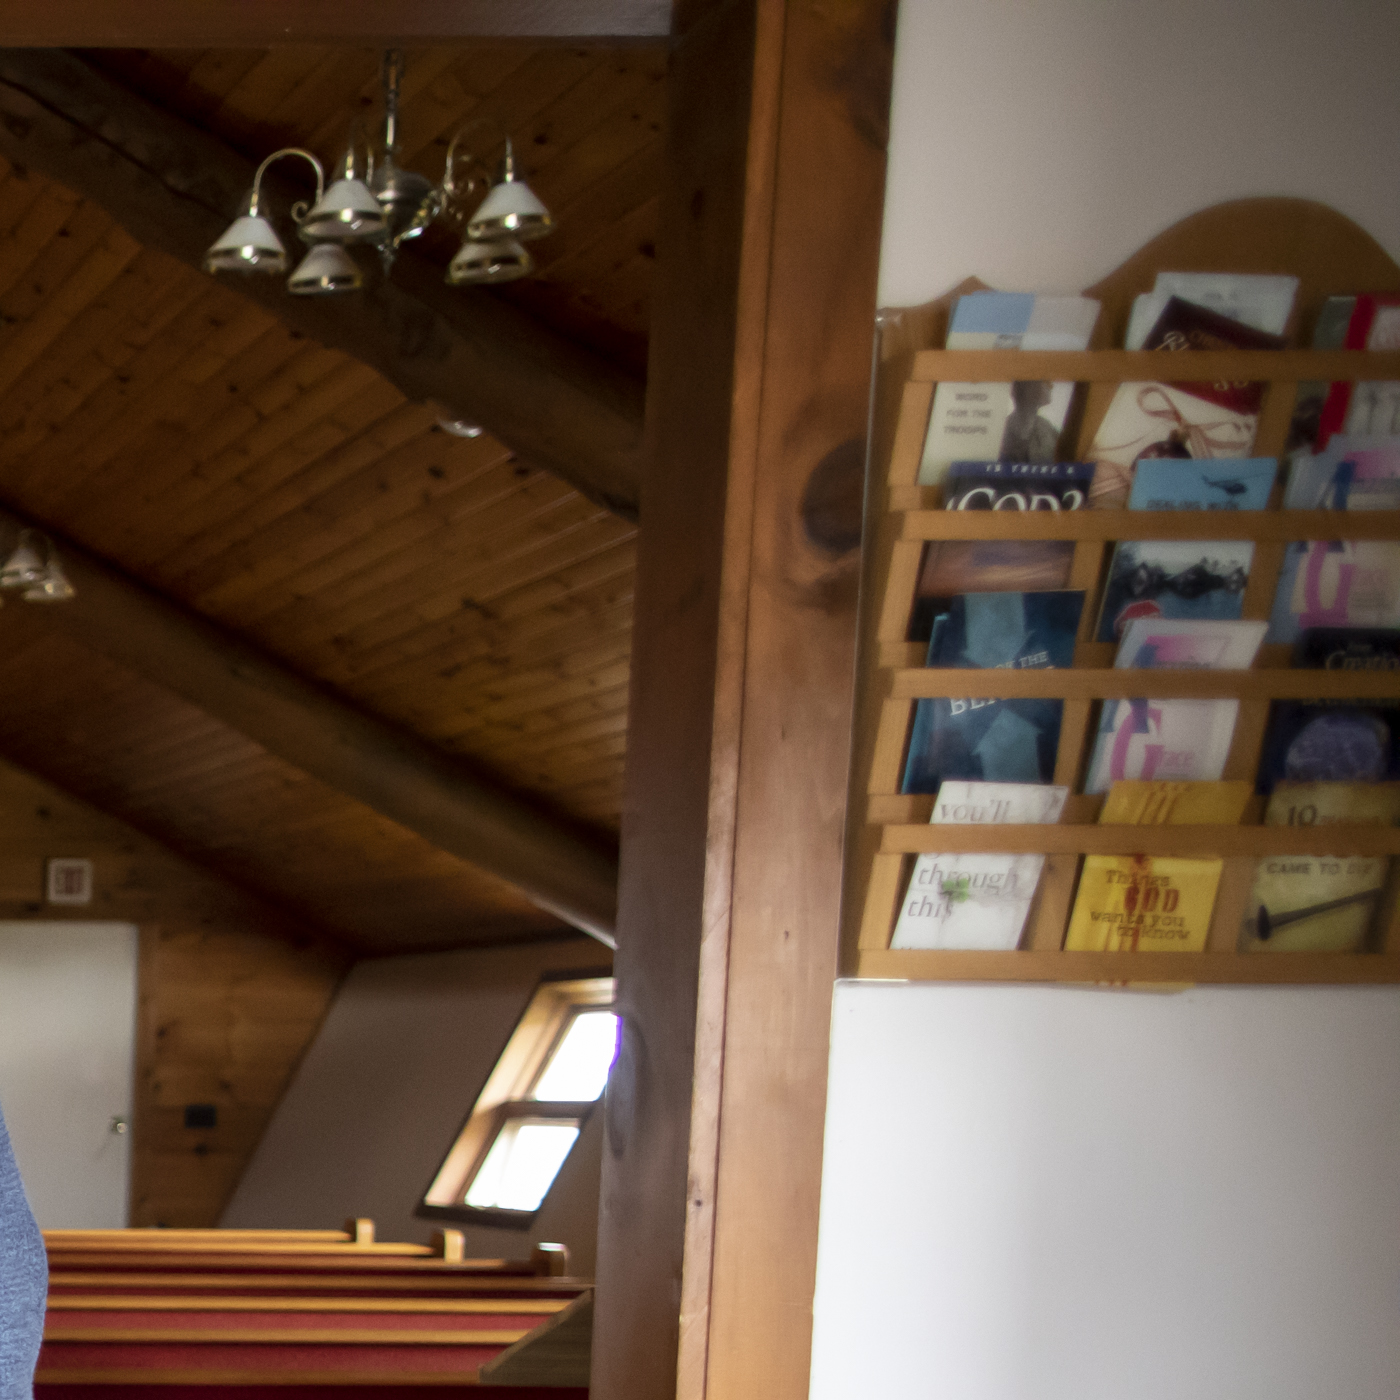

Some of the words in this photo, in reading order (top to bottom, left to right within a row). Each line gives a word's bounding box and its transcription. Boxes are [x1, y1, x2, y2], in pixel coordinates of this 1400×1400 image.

[1019, 651, 1050, 668] THE
[918, 863, 1019, 895] through
[1106, 870, 1171, 887] Things
[907, 895, 954, 918] this
[1091, 910, 1145, 925] wants
[1150, 912, 1185, 928] you
[1140, 926, 1191, 940] know
